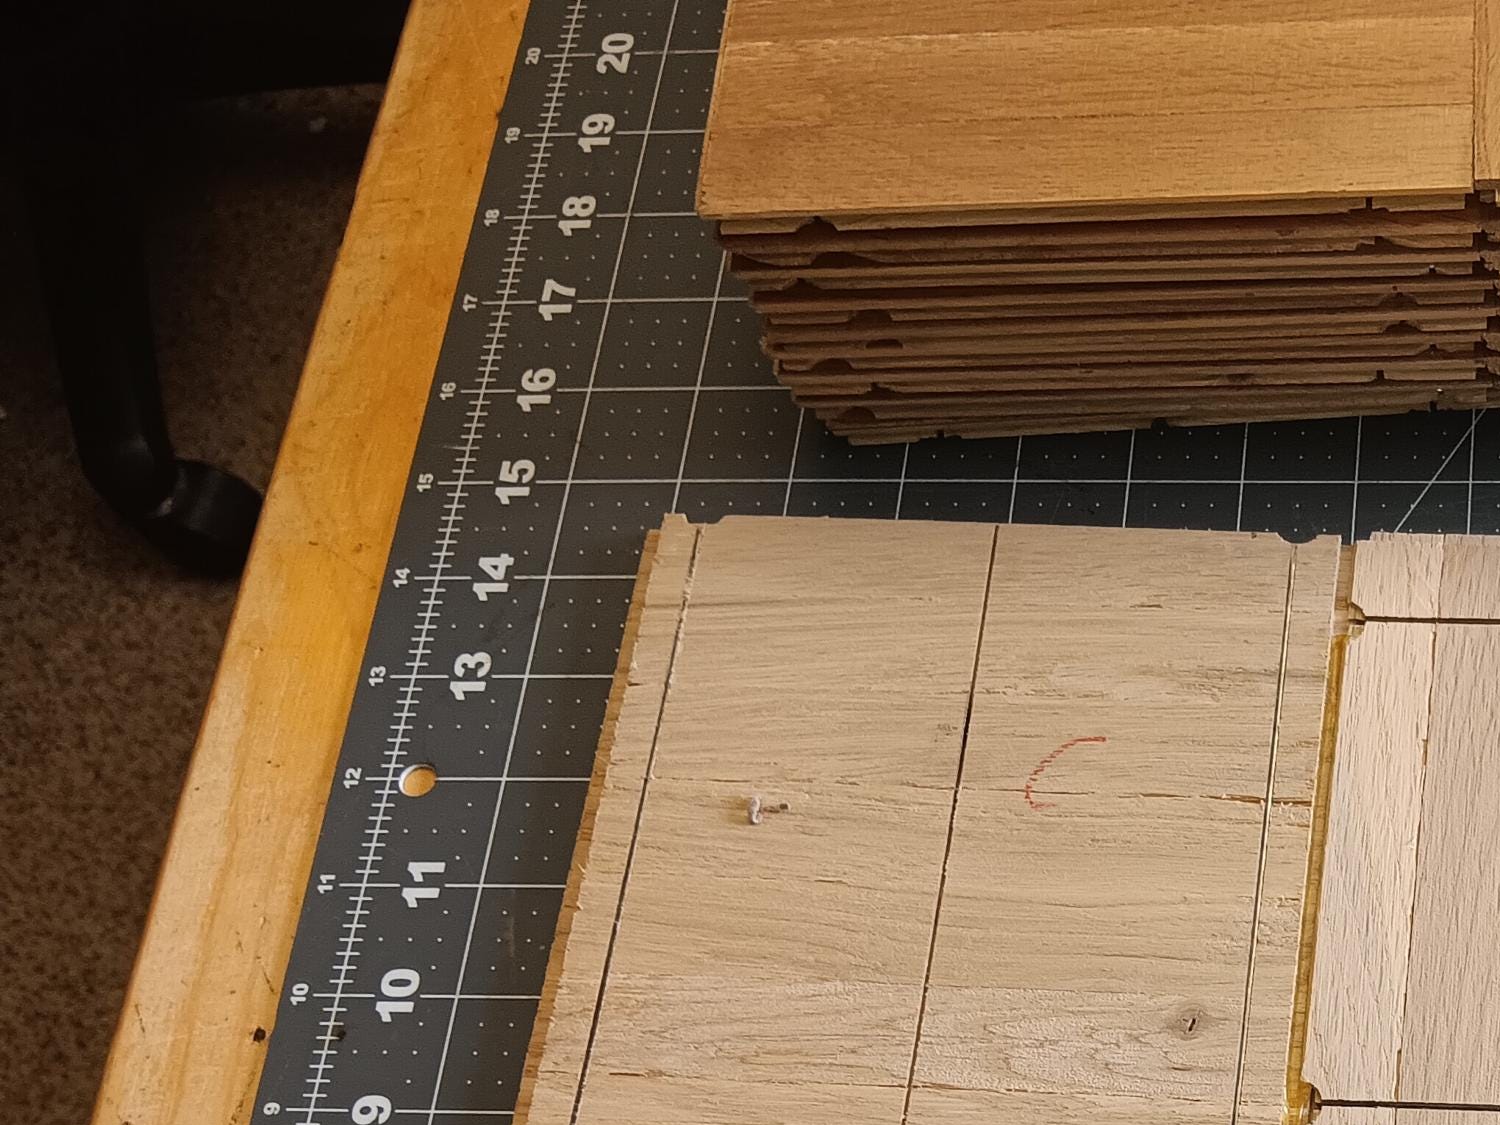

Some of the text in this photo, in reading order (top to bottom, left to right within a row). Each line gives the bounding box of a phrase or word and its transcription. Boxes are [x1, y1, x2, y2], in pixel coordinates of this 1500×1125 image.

[524, 47, 542, 65] 20
[596, 32, 635, 74] 20
[504, 126, 521, 144] 19
[577, 113, 616, 153] 19
[483, 208, 500, 227] 18
[557, 195, 597, 237] 18
[462, 293, 478, 313] 17
[538, 278, 577, 322] 17
[439, 382, 457, 401] 16
[516, 367, 557, 413] 16
[416, 473, 434, 493] 15
[494, 459, 536, 505] 15
[392, 567, 411, 588] 14
[472, 553, 515, 602] 14
[368, 665, 387, 687] 13
[449, 651, 492, 701] 13
[343, 767, 362, 789] 12
[316, 874, 336, 894] 11
[401, 861, 446, 908] 11
[289, 983, 309, 1006] 10
[375, 968, 421, 1023] 10
[263, 1101, 281, 1116] 9
[351, 1094, 392, 1125] 9
